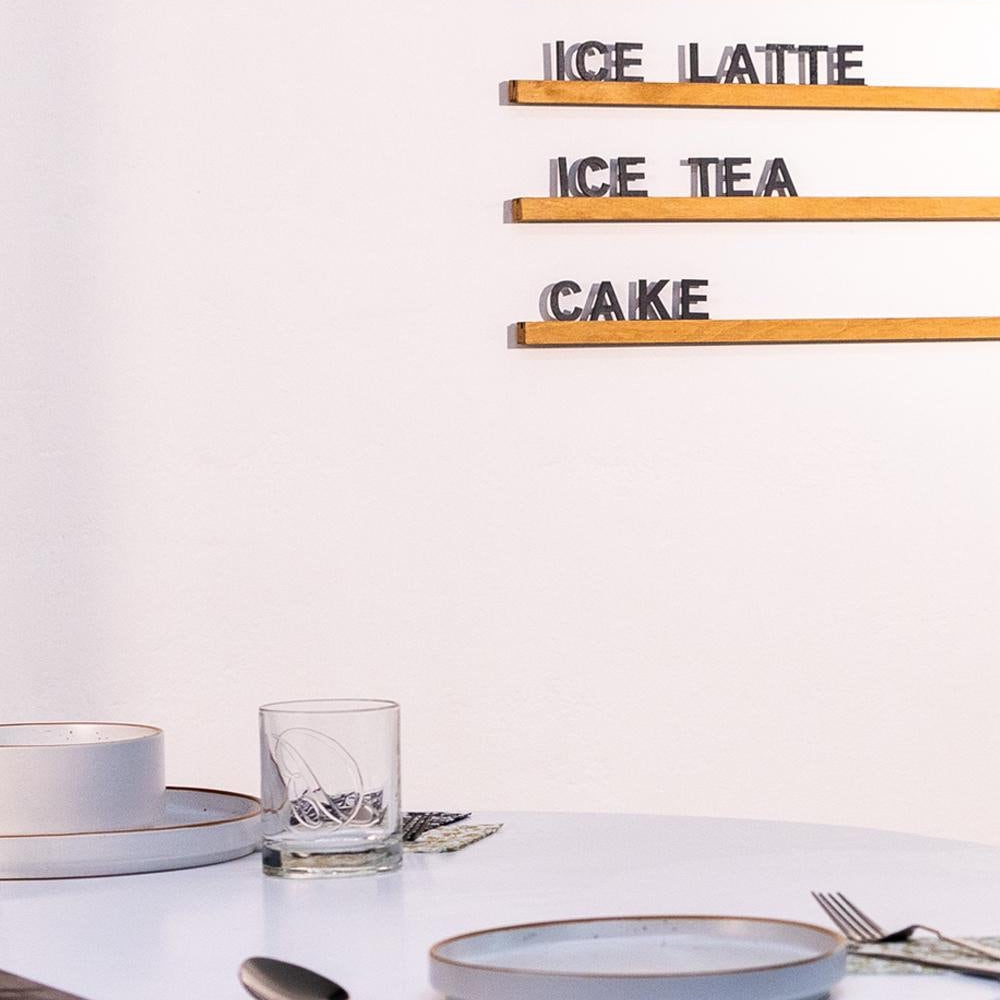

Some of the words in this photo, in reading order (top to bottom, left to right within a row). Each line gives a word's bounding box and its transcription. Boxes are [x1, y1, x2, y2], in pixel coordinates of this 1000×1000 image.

[555, 40, 644, 83] ICE
[689, 42, 866, 86] LATTE
[557, 156, 649, 198] ICE
[688, 157, 798, 198] TEA
[550, 279, 710, 321] CAKE
